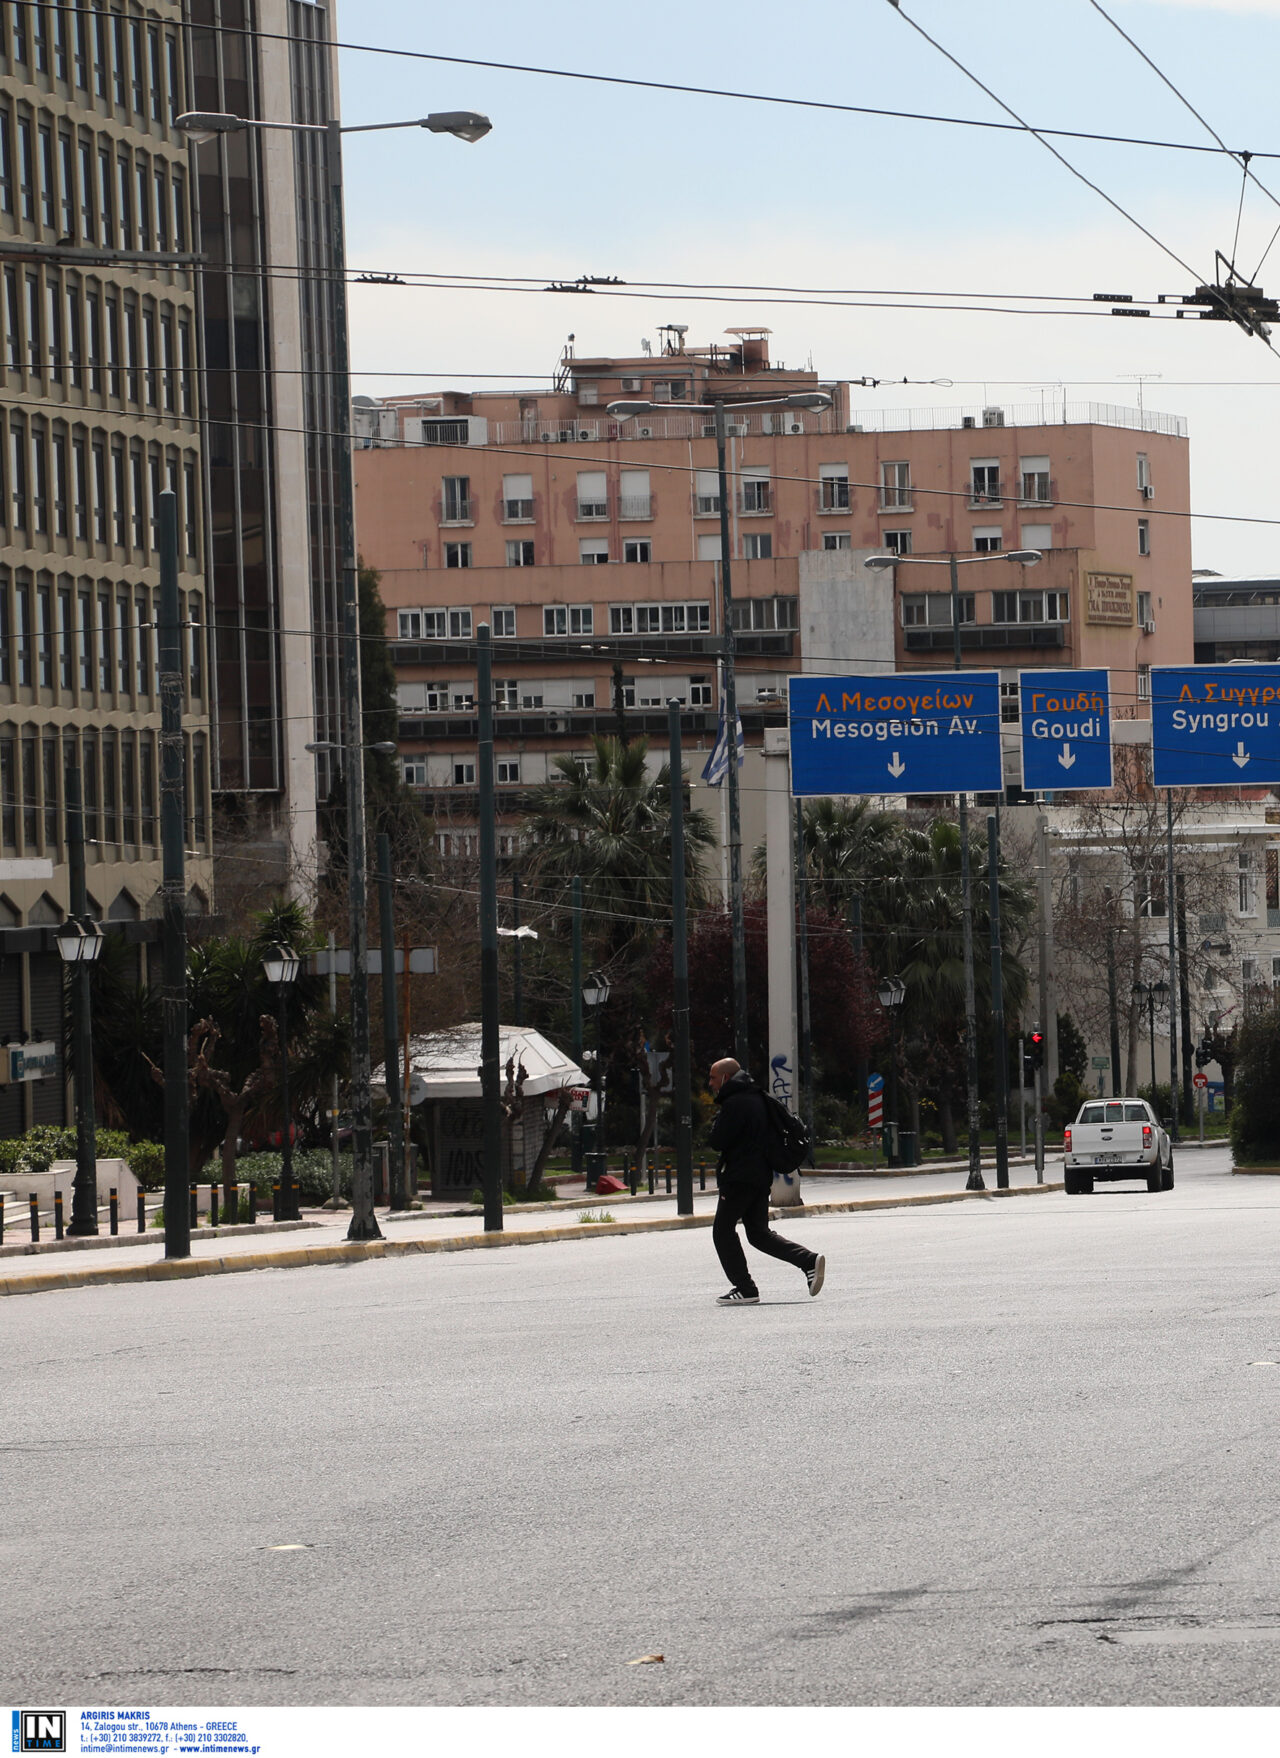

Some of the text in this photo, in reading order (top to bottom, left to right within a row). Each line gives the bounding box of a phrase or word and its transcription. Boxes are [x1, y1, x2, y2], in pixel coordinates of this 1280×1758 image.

[1032, 692, 1104, 716] Γουδή
[812, 715, 982, 741] Mesogeion Av.
[1032, 718, 1100, 739] Goudi
[1172, 709, 1269, 733] Syngrou
